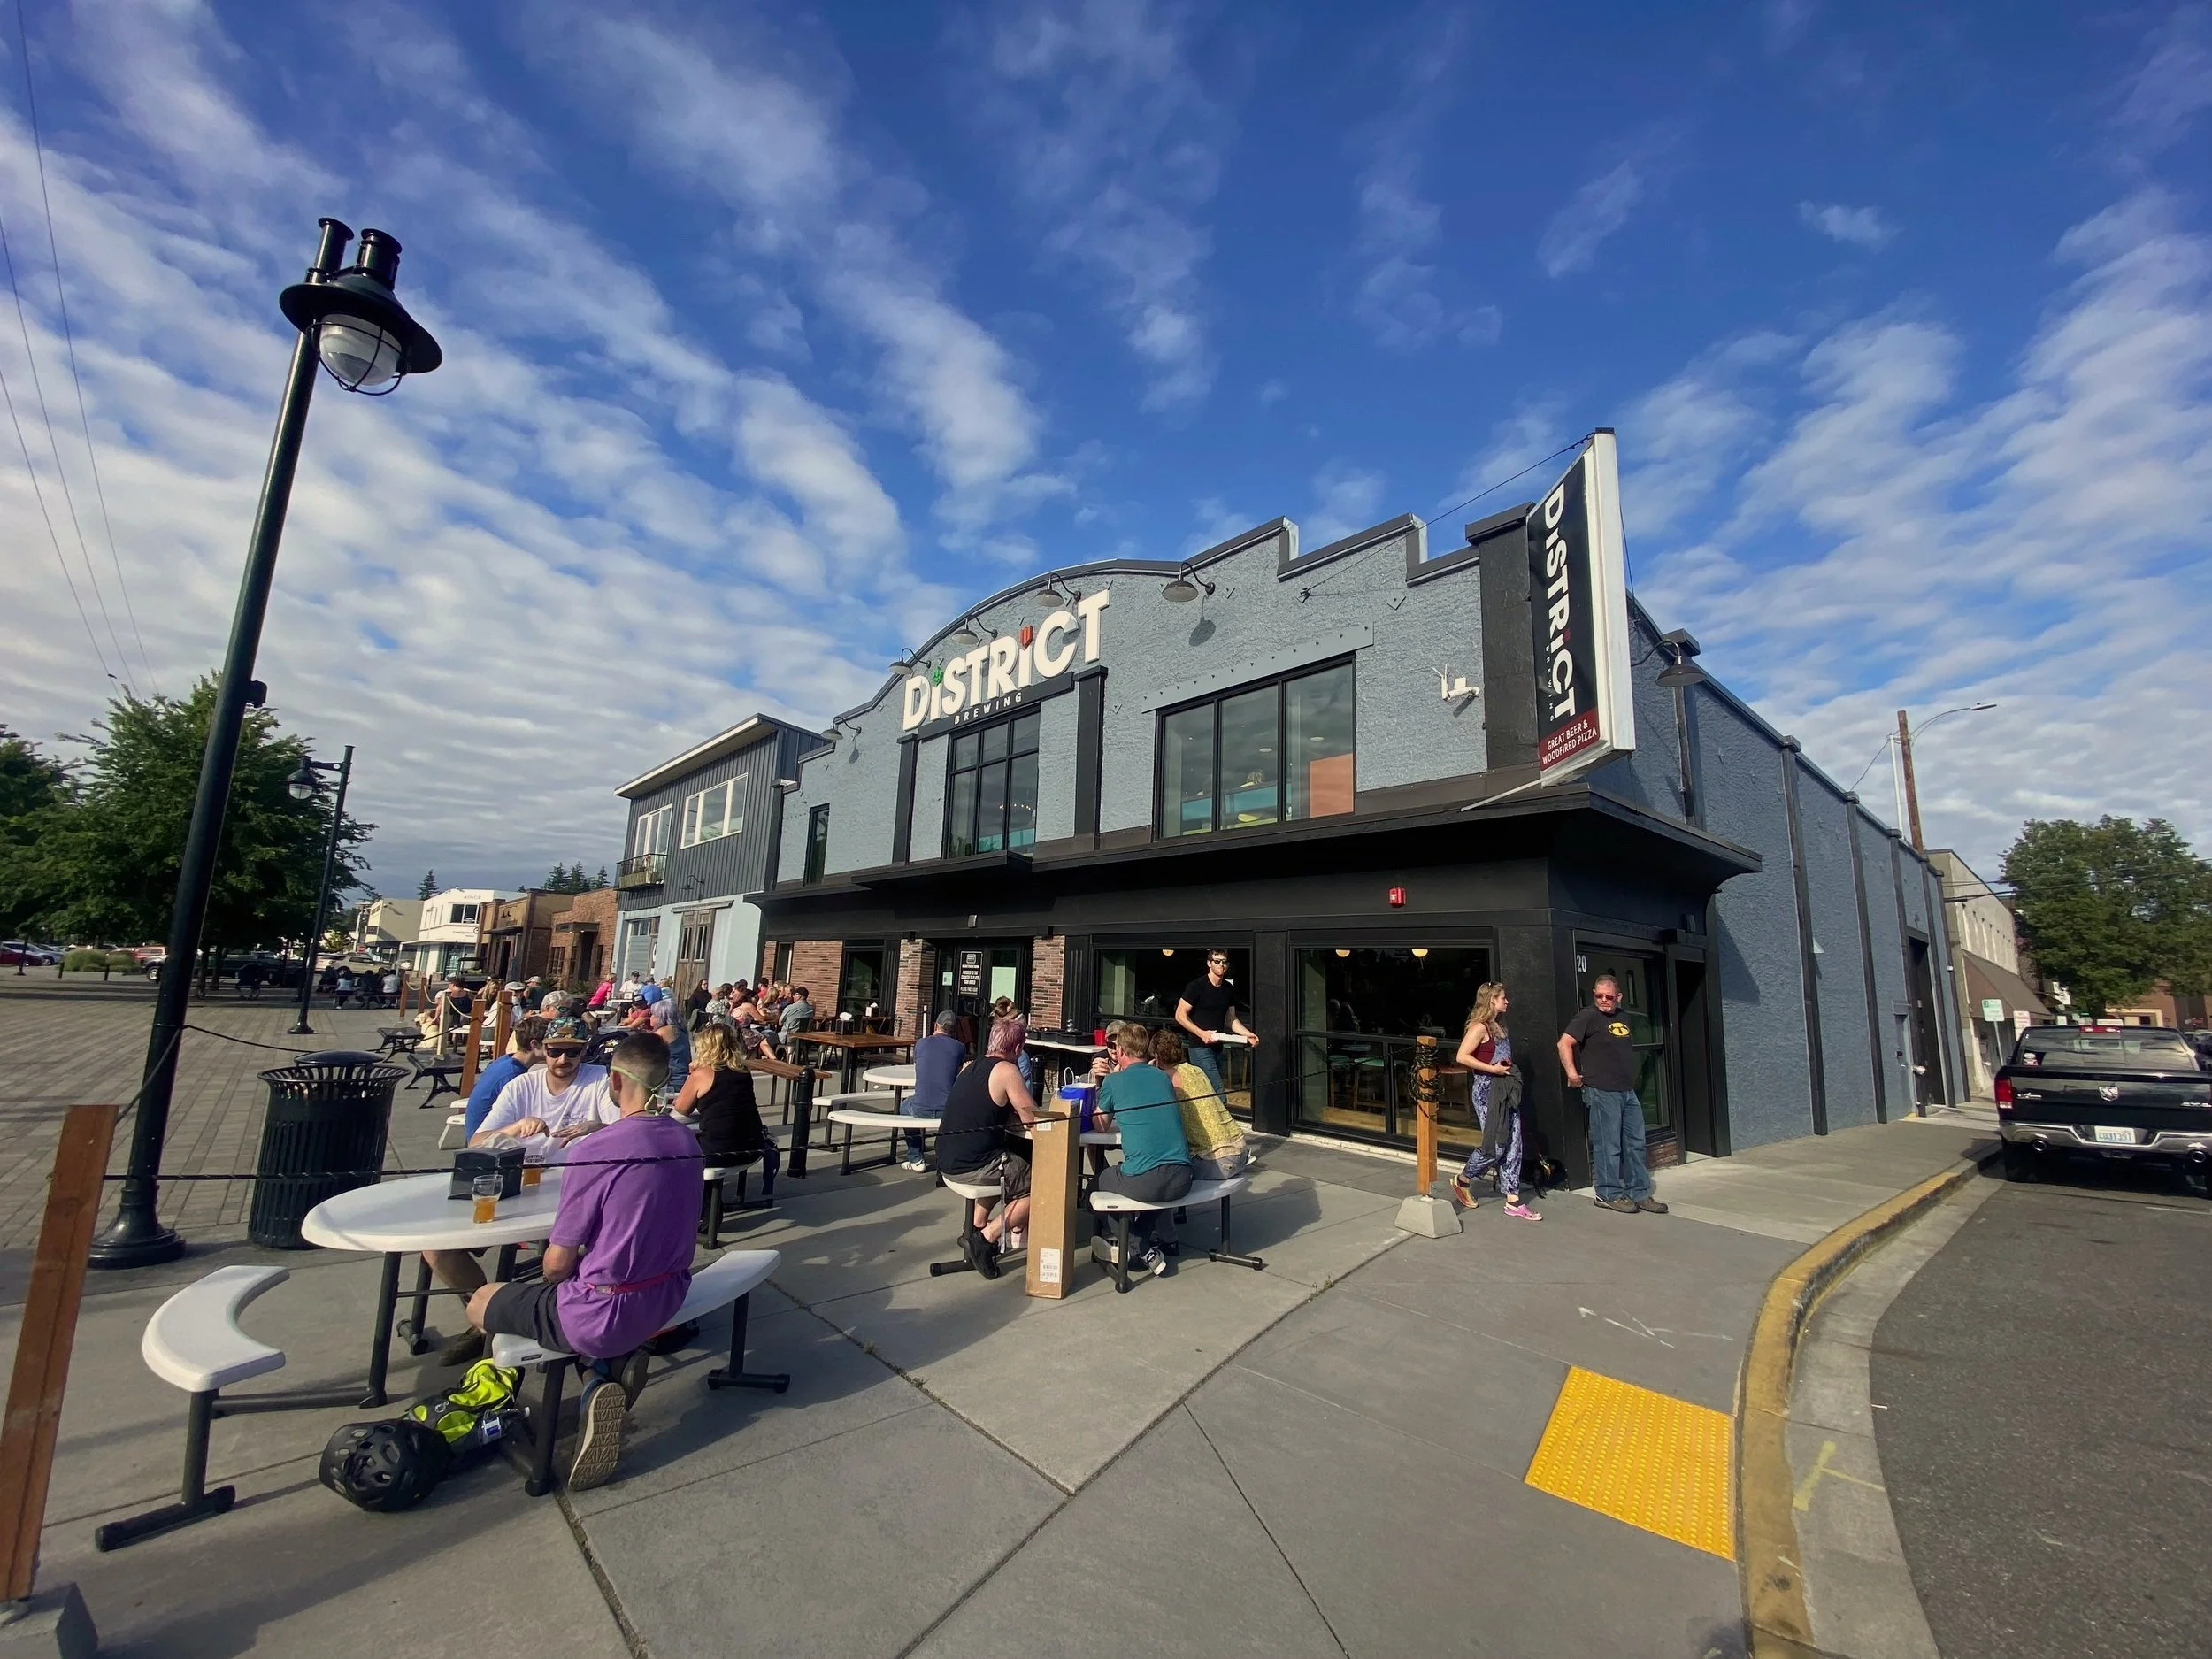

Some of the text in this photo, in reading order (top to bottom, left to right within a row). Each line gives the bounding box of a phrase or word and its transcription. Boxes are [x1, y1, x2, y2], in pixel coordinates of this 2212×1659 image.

[954, 692, 1022, 725] BREWING
[1541, 726, 1597, 765] WOODFIRED PIZZA
[1547, 719, 1588, 750] GREAT BEER &
[1576, 954, 1587, 973] 20
